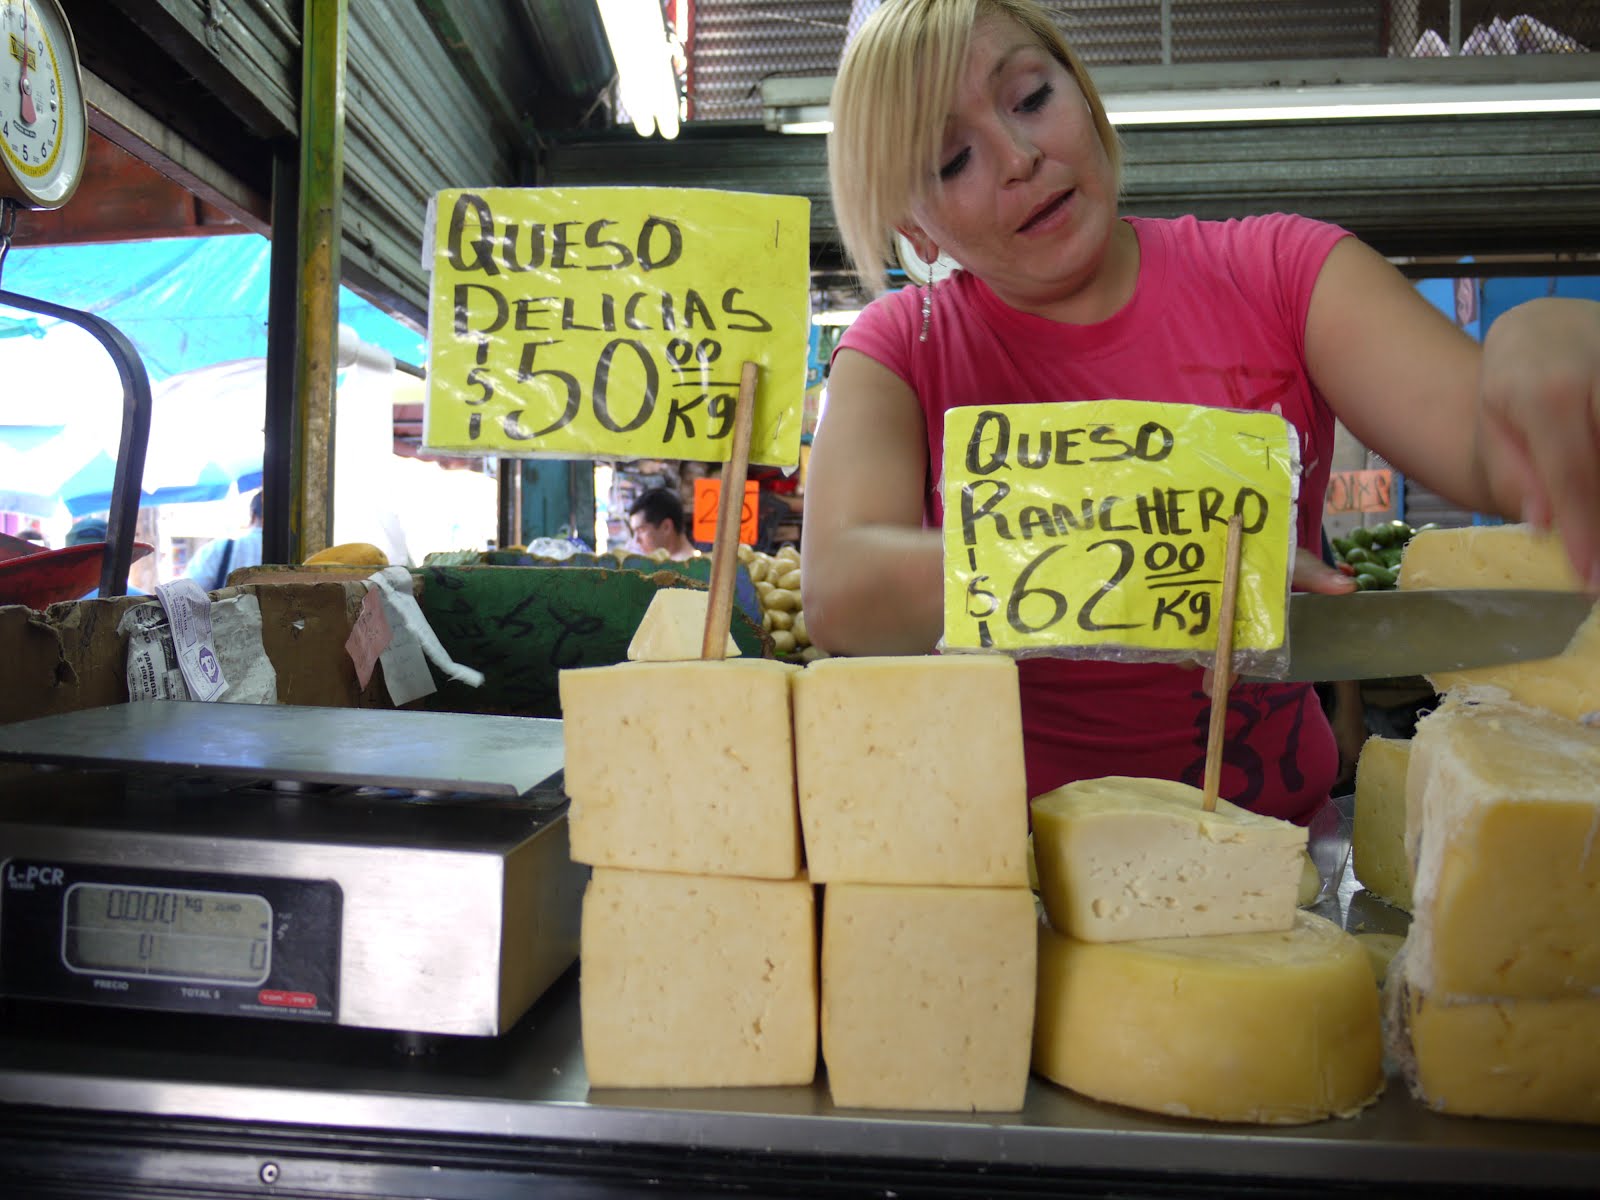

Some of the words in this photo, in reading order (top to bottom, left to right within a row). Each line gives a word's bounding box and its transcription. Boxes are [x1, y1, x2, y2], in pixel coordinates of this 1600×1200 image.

[50, 79, 56, 96] 8
[2, 120, 9, 138] 4
[51, 119, 57, 135] 7
[22, 144, 28, 161] 5
[41, 142, 47, 158] 6
[447, 193, 683, 276] QUESO
[454, 283, 773, 335] DELICIAS
[966, 410, 1174, 475] QUESO
[961, 479, 1269, 546] RANCHERO
[7, 865, 64, 886] L-PCR
[94, 979, 129, 991] PRECIO
[181, 987, 212, 1000] TOTAL
